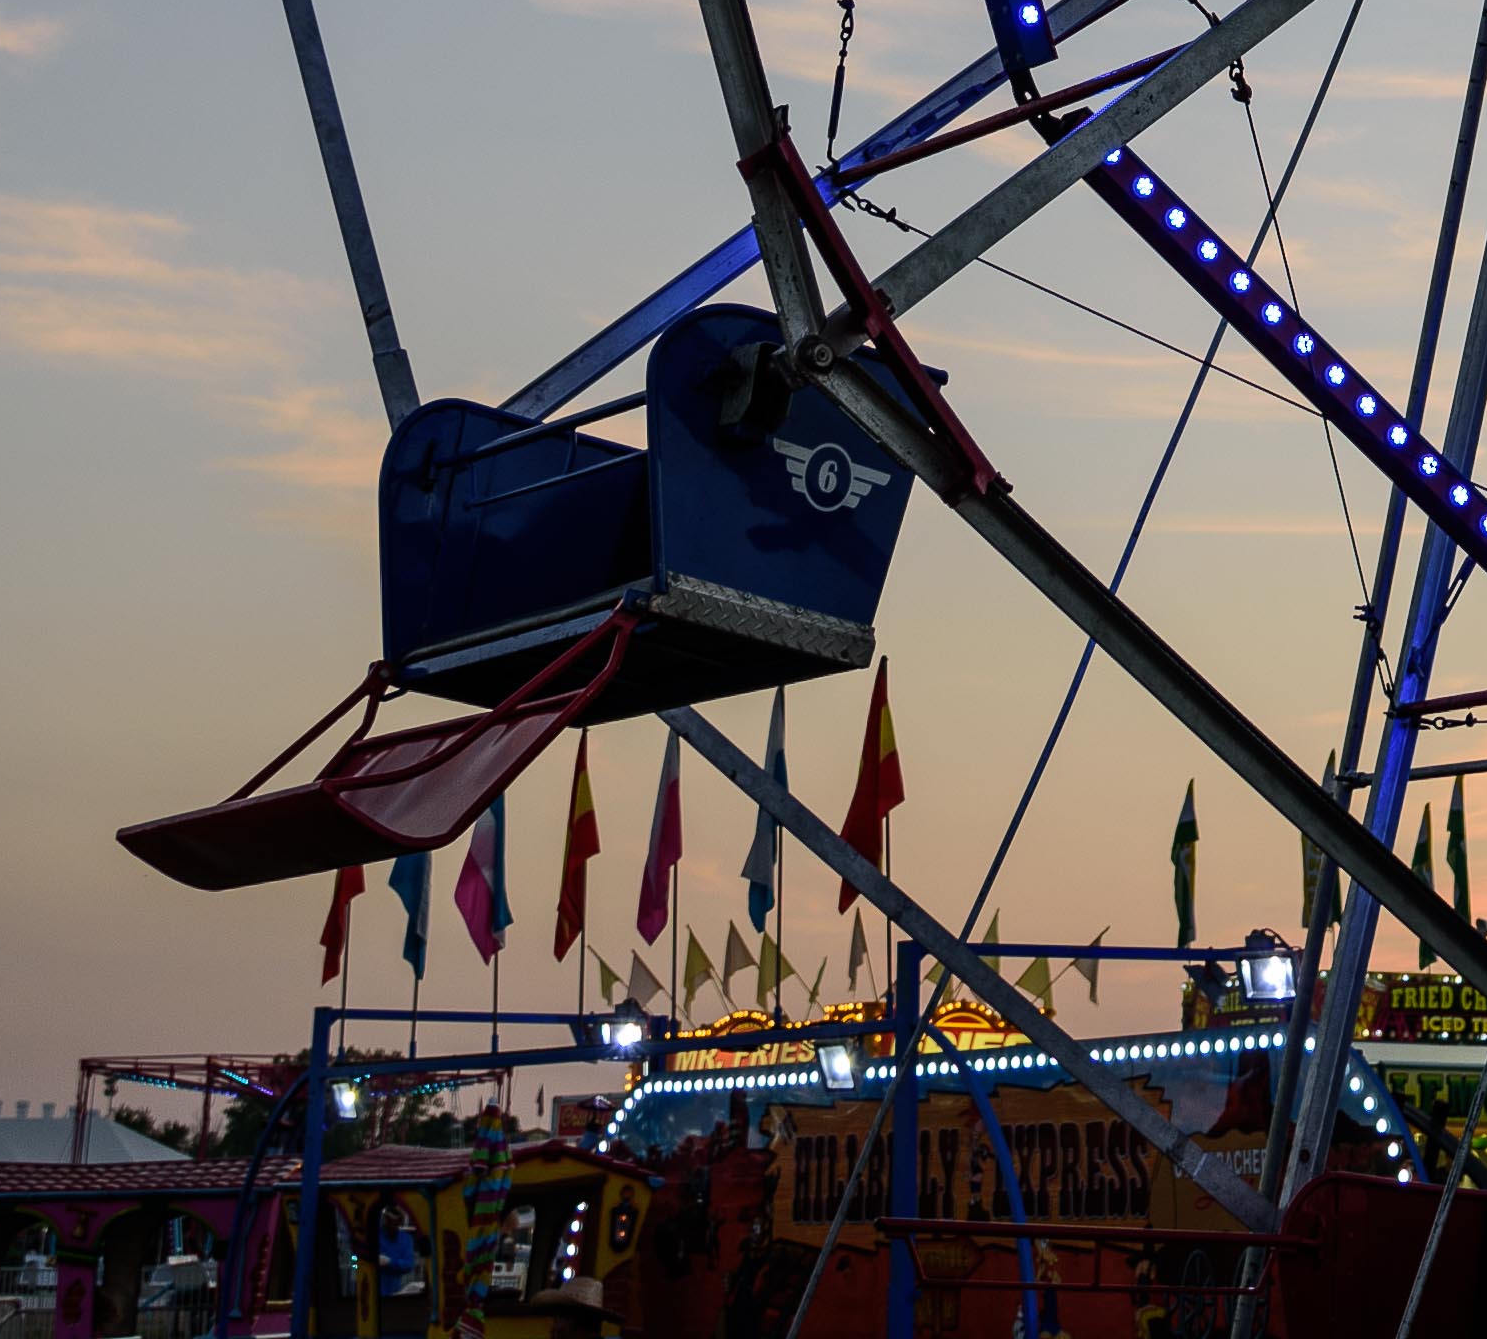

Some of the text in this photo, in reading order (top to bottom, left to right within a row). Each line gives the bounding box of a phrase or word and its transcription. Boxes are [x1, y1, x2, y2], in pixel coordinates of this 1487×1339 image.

[818, 459, 838, 494] 6
[1390, 984, 1454, 1011] FRIED
[1421, 1014, 1467, 1034] ICED
